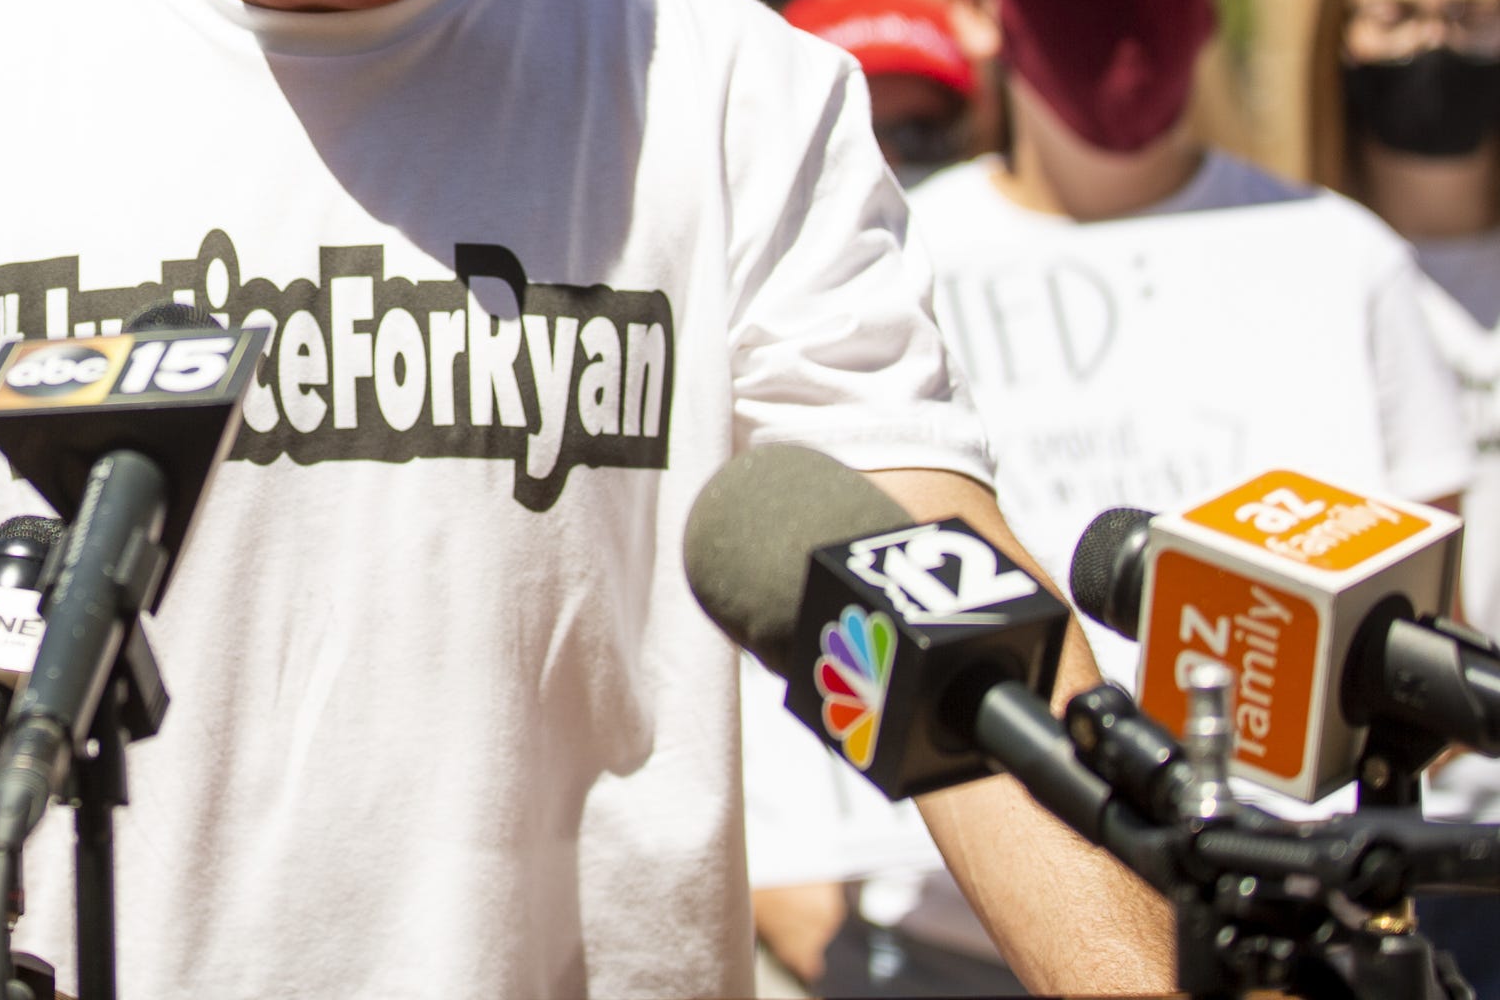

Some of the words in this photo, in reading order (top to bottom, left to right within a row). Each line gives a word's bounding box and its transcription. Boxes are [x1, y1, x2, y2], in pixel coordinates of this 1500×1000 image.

[6, 355, 110, 388] abc
[120, 337, 236, 394] 15
[1234, 487, 1326, 534] az
[1264, 500, 1401, 562] family
[883, 530, 1039, 618] 12
